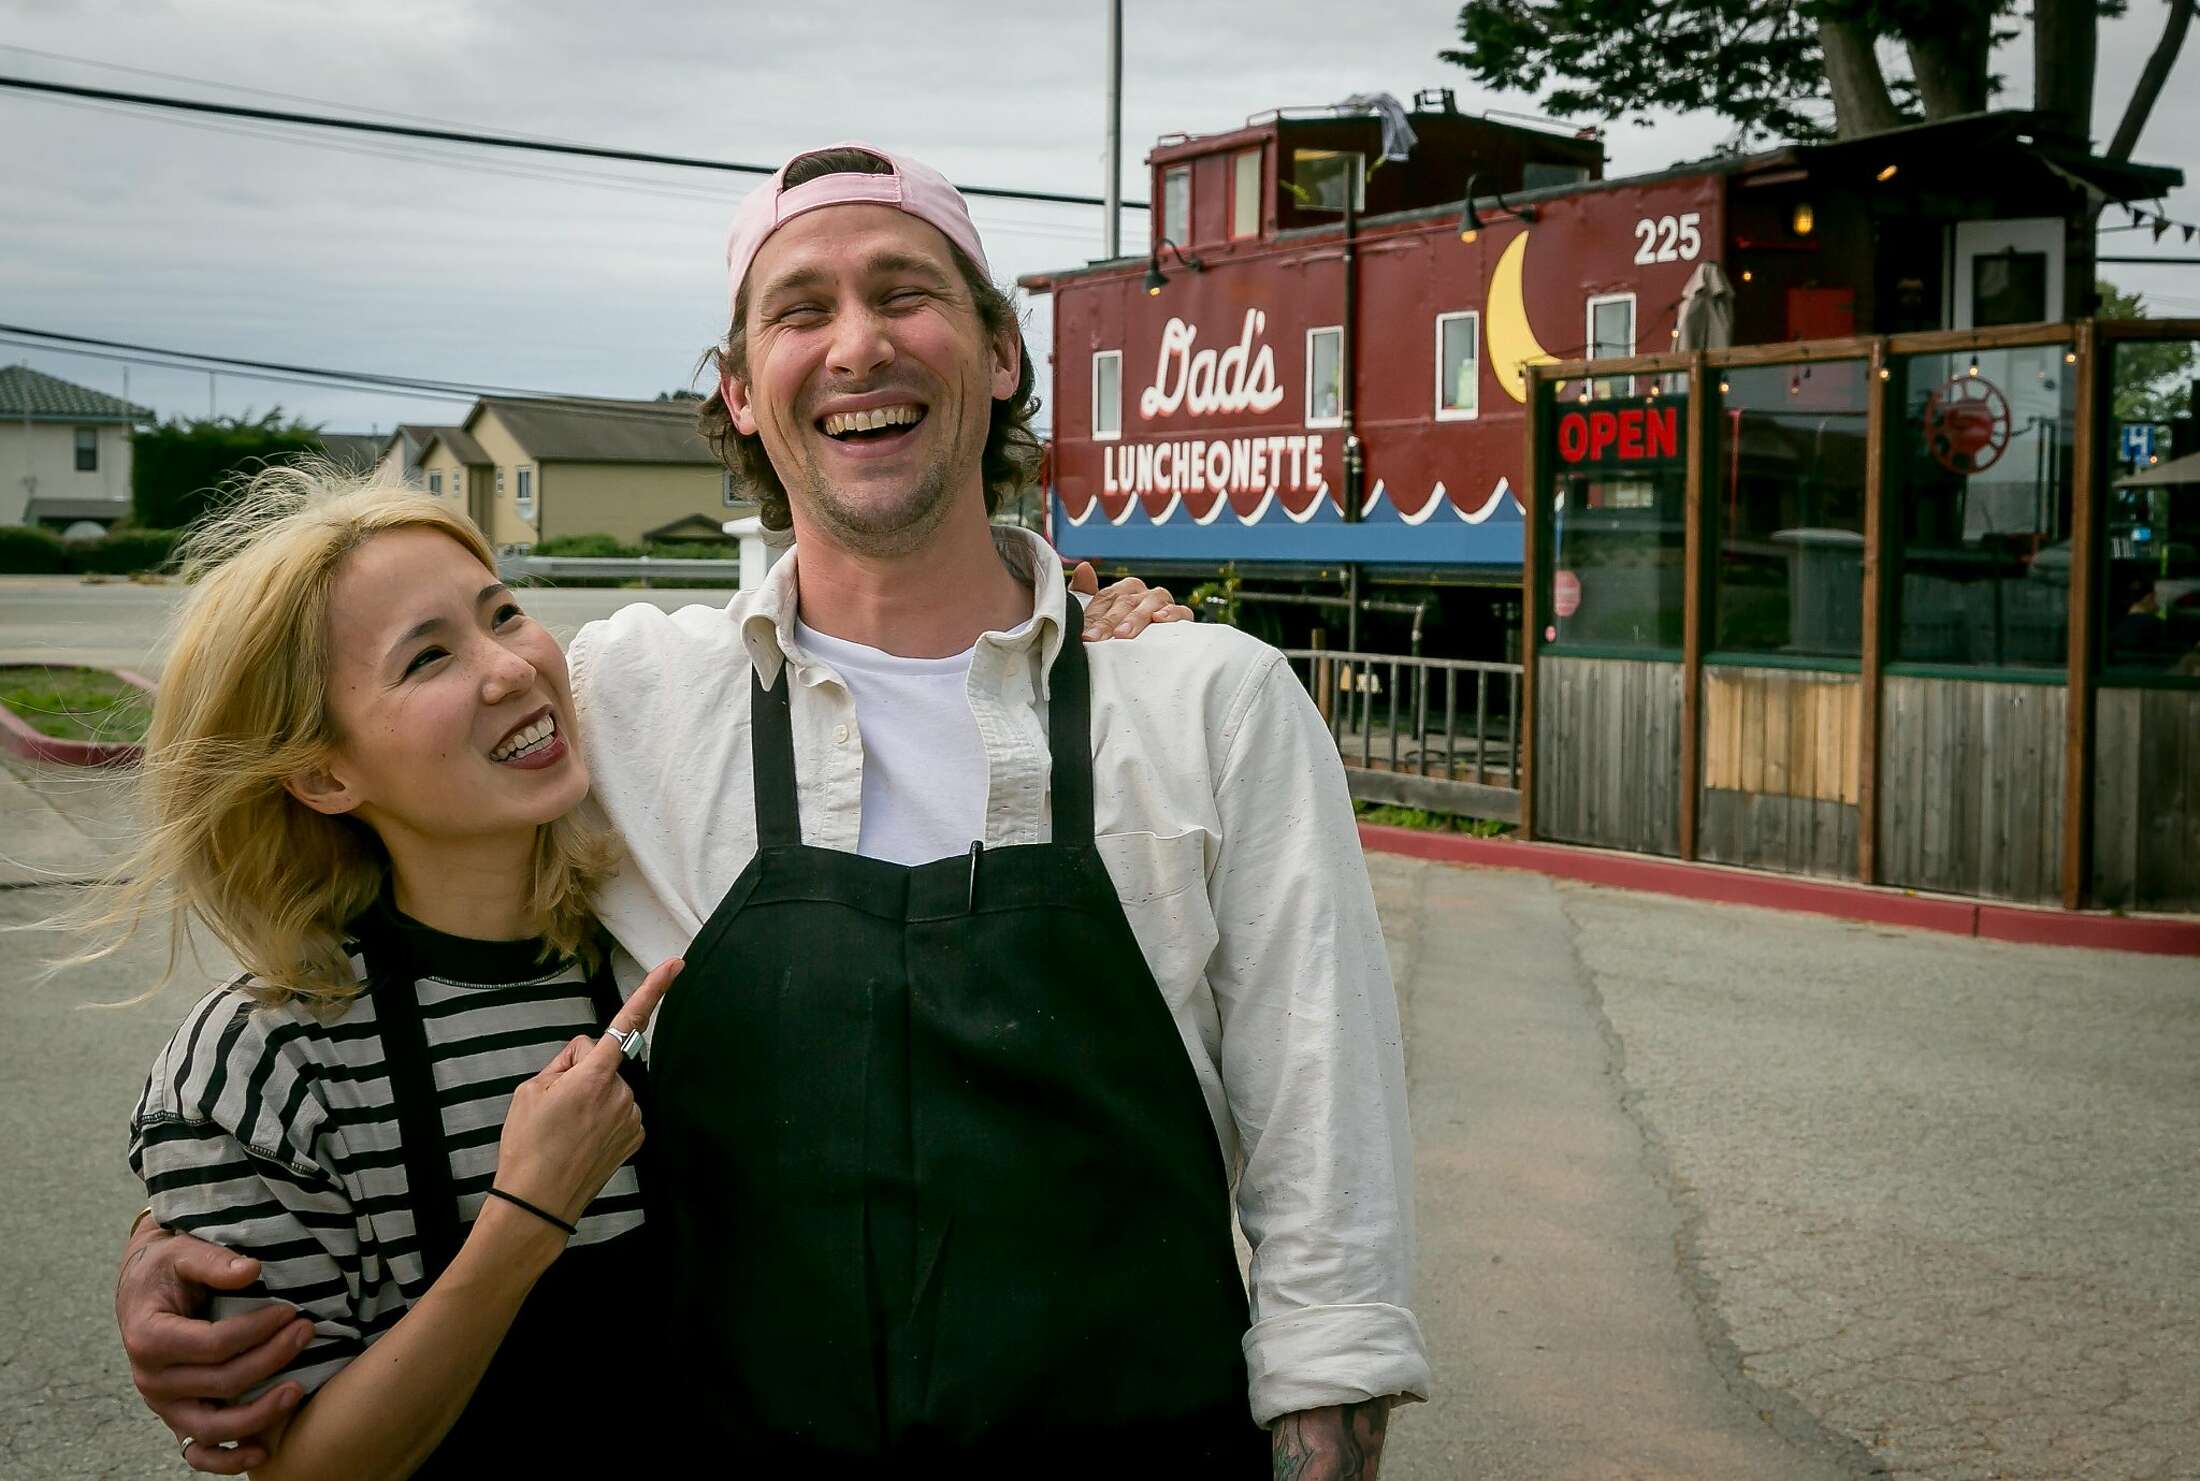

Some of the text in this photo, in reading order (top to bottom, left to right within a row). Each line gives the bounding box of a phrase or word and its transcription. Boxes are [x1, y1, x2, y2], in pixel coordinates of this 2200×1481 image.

[1634, 212, 1702, 266] 225
[1140, 307, 1285, 419] Dad's
[1558, 407, 1677, 463] OPEN
[1103, 434, 1324, 495] LUNCHEONETTE
